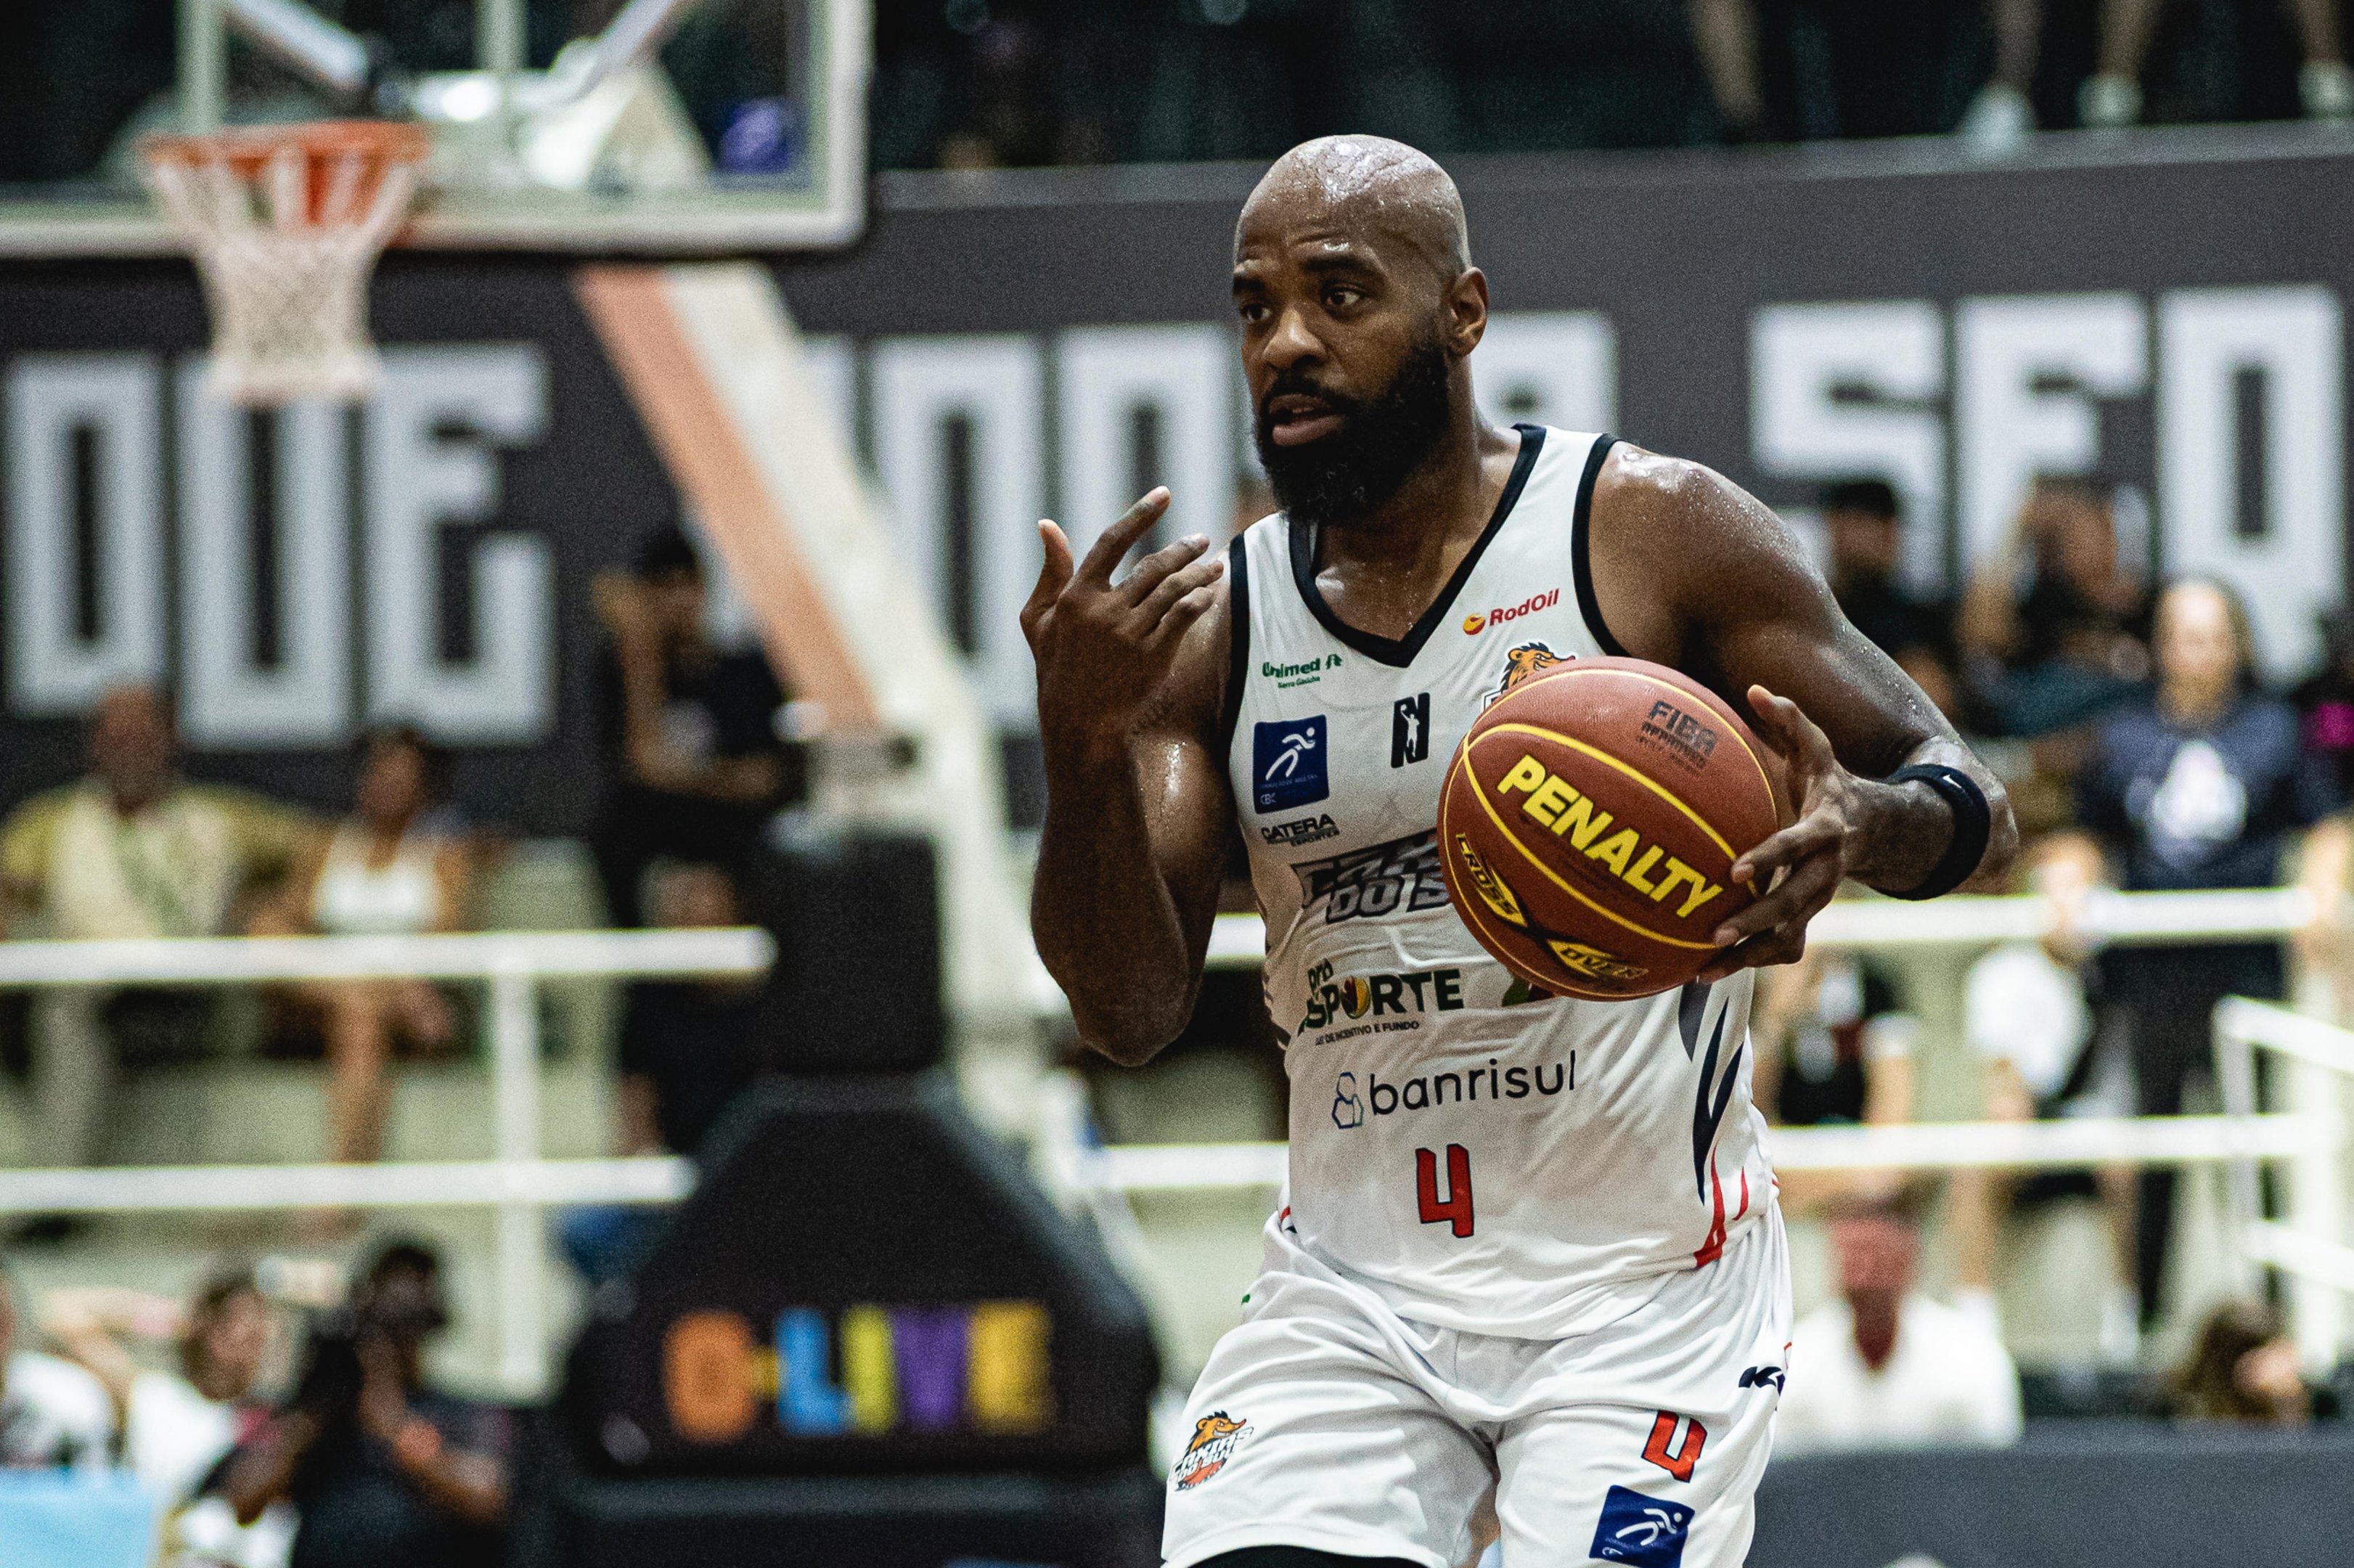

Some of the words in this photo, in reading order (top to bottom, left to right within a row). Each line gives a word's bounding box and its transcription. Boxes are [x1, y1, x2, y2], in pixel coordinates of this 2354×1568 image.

[1489, 588, 1560, 626] RodOil
[1262, 657, 1321, 678] Unimed
[1648, 701, 1718, 757] FIBA
[1497, 754, 1723, 918] PENALTY
[1382, 1020, 1421, 1032] FUNDO
[1368, 1050, 1577, 1116] banrisul
[1415, 1143, 1474, 1238] 4
[1640, 1410, 1708, 1483] 4
